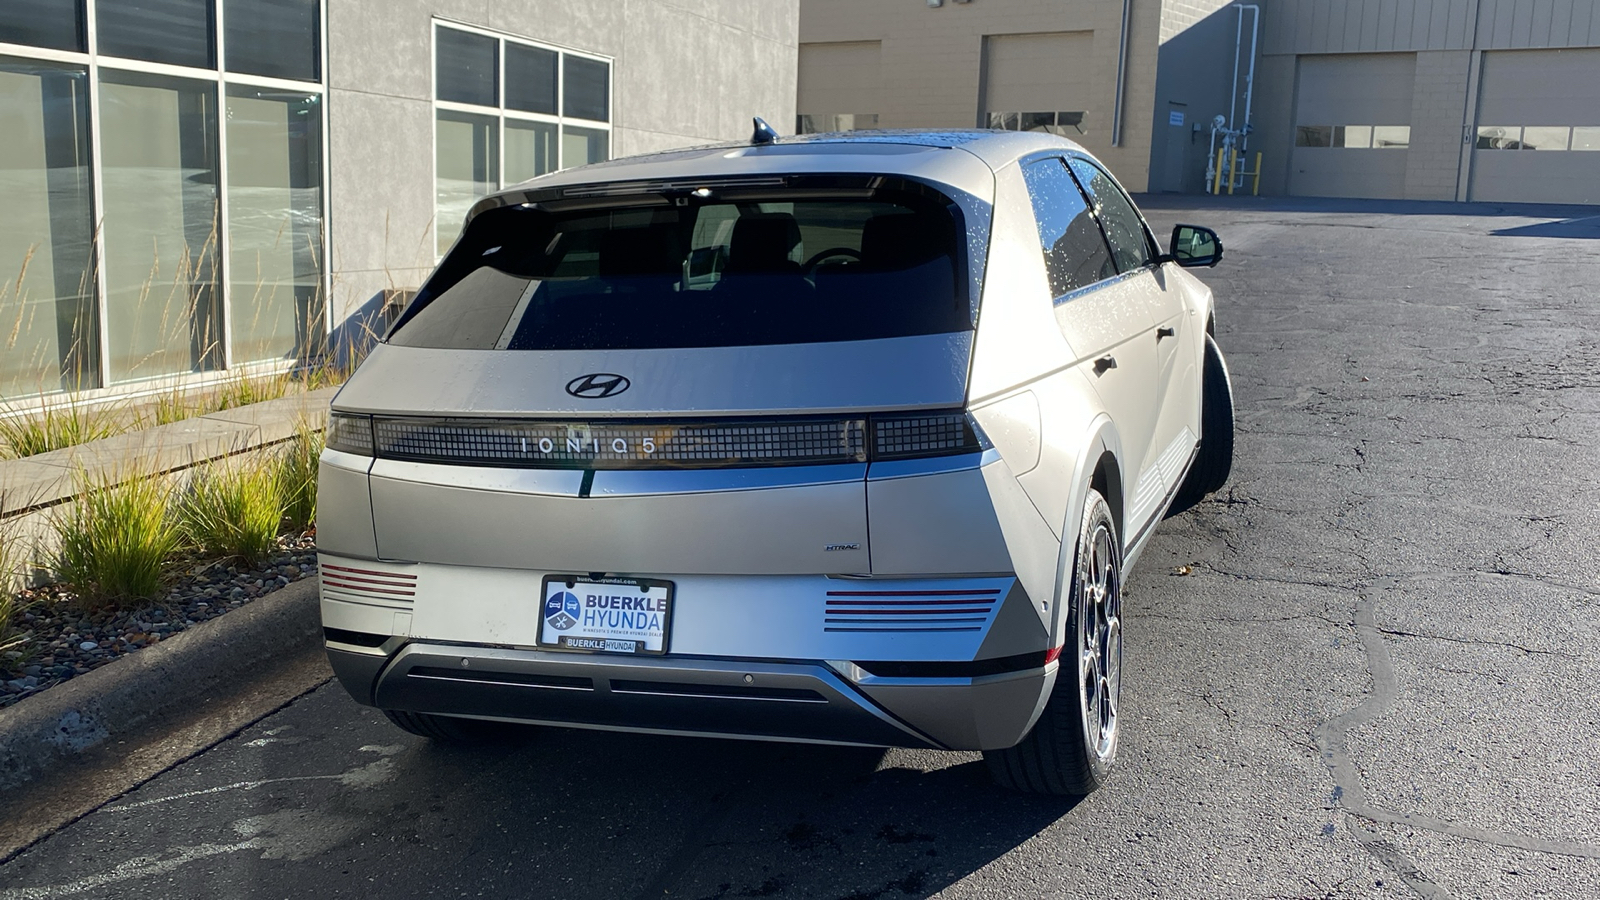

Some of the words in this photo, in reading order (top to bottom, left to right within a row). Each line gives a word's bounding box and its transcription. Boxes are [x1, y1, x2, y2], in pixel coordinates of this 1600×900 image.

[576, 576, 638, 585] buerkyundai.com
[585, 594, 667, 612] BUERKLE
[567, 638, 605, 649] BUERKLE
[605, 641, 636, 652] HYUNDAI
